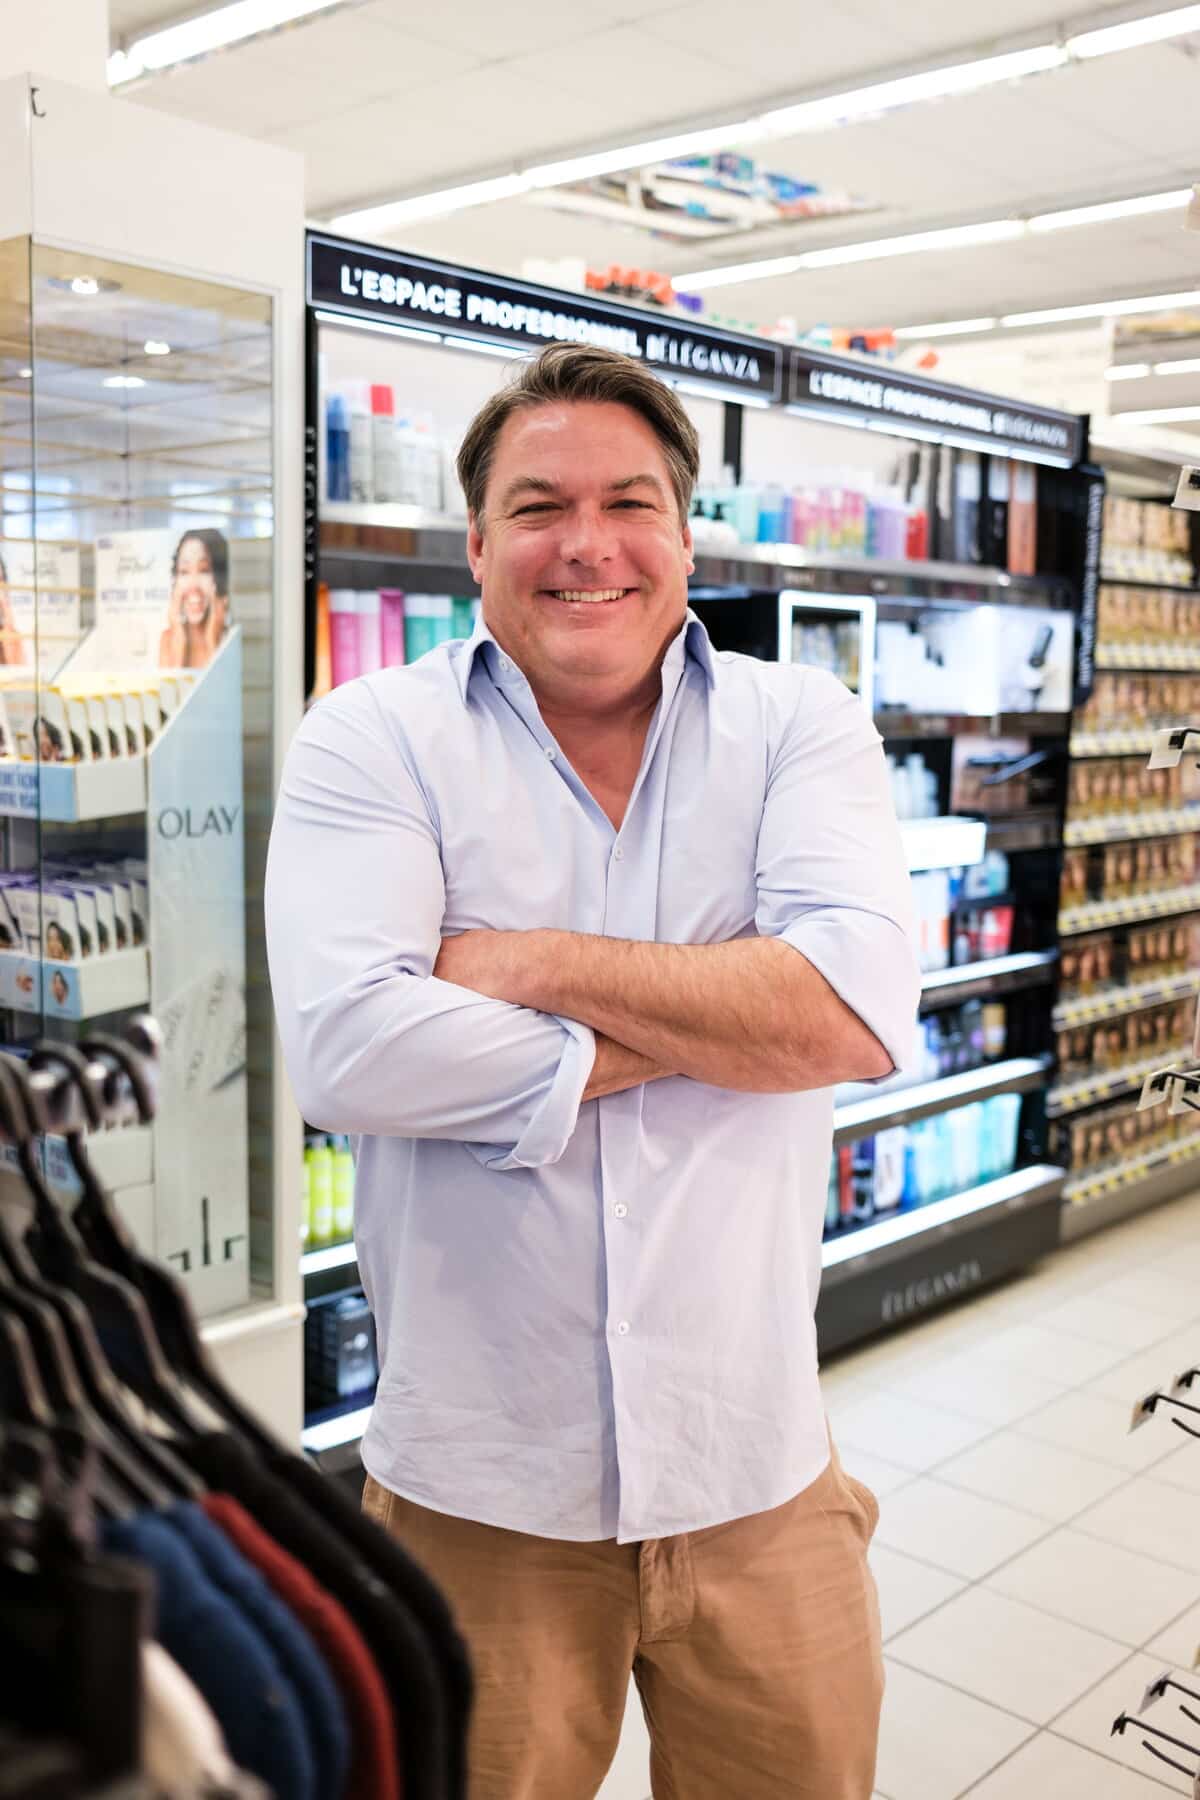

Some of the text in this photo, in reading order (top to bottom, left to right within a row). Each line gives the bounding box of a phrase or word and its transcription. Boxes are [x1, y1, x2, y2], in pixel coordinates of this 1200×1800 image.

[341, 265, 461, 318] L'ESPACE
[467, 294, 642, 357] PROFESSIONNEL
[158, 805, 240, 840] OLAY
